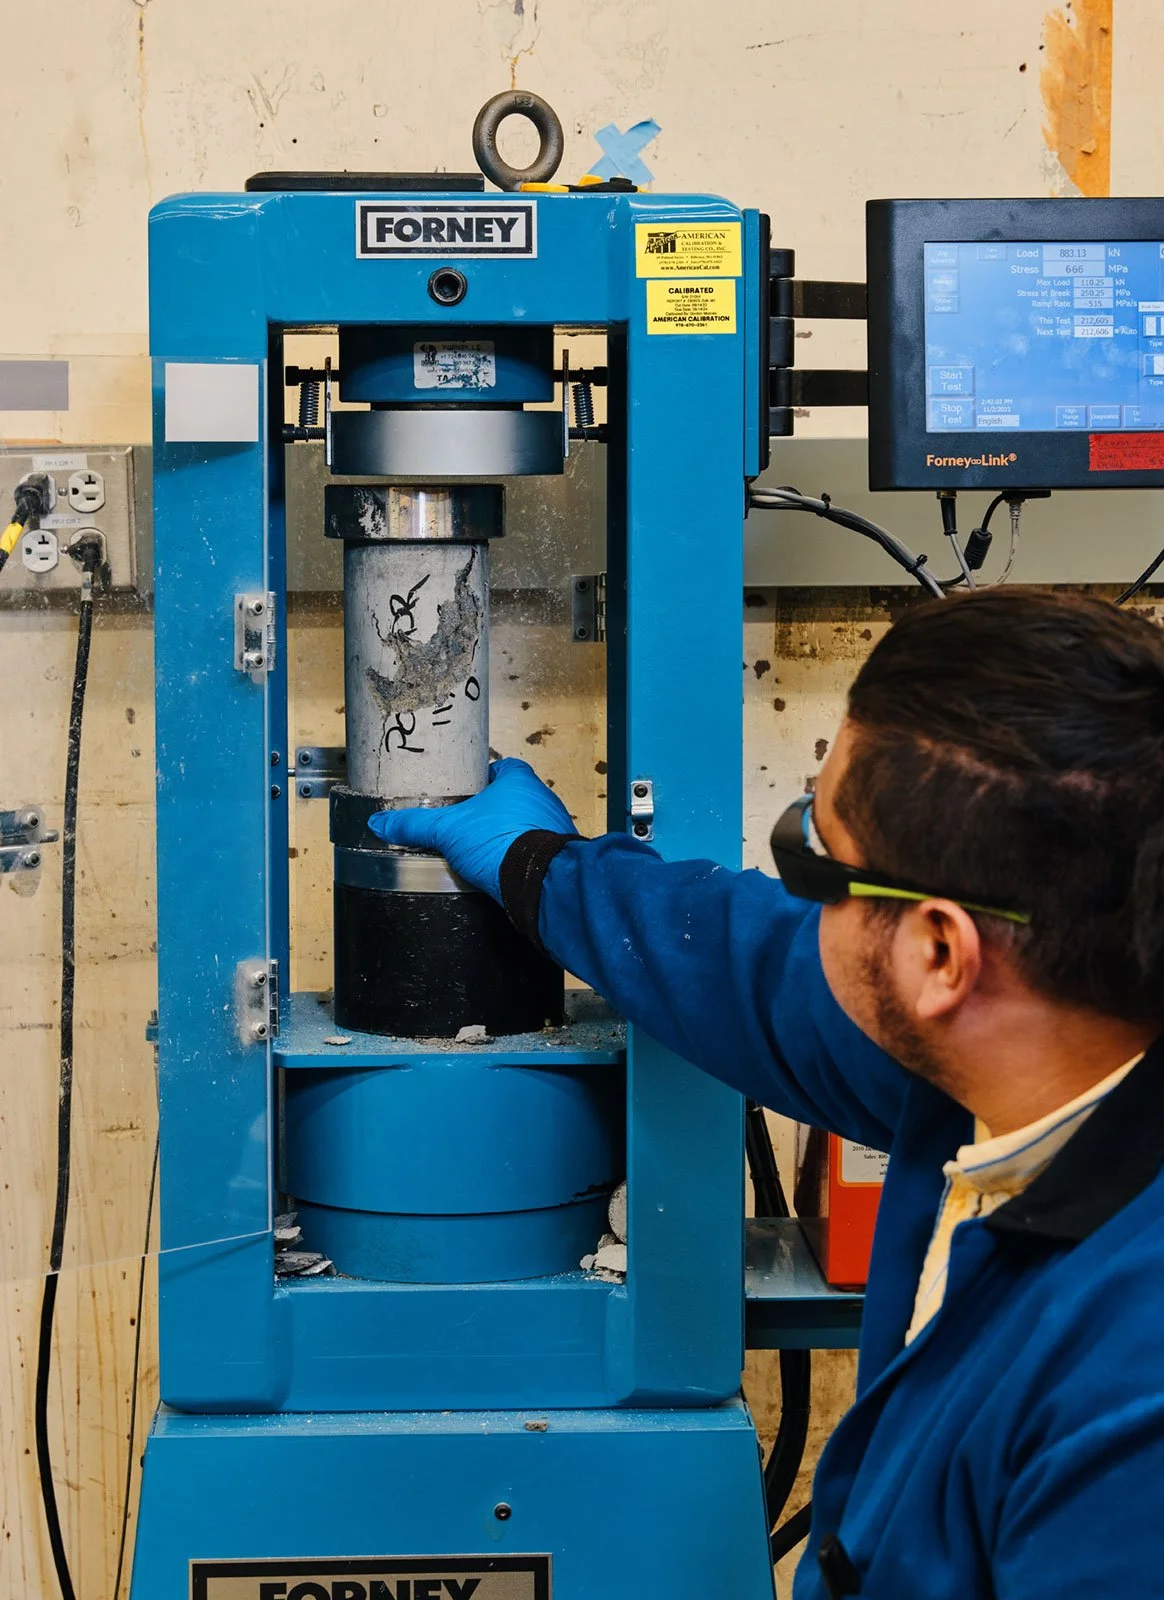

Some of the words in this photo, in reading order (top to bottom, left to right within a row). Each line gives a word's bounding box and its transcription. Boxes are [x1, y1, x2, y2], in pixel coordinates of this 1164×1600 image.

[376, 217, 519, 242] FORNEY
[1016, 249, 1039, 258] Load
[1059, 249, 1087, 258] 883.13
[1108, 249, 1121, 257] kN
[1010, 265, 1040, 274] Stress
[1065, 265, 1084, 273] 666
[1108, 265, 1129, 273] MPa
[1081, 317, 1109, 325] 212,605
[1036, 328, 1053, 336] Next
[1056, 328, 1071, 336] Test
[940, 370, 963, 379] Start
[941, 382, 962, 391] Test
[940, 403, 963, 415] Stop
[942, 415, 962, 424] Test
[978, 417, 1003, 425] English
